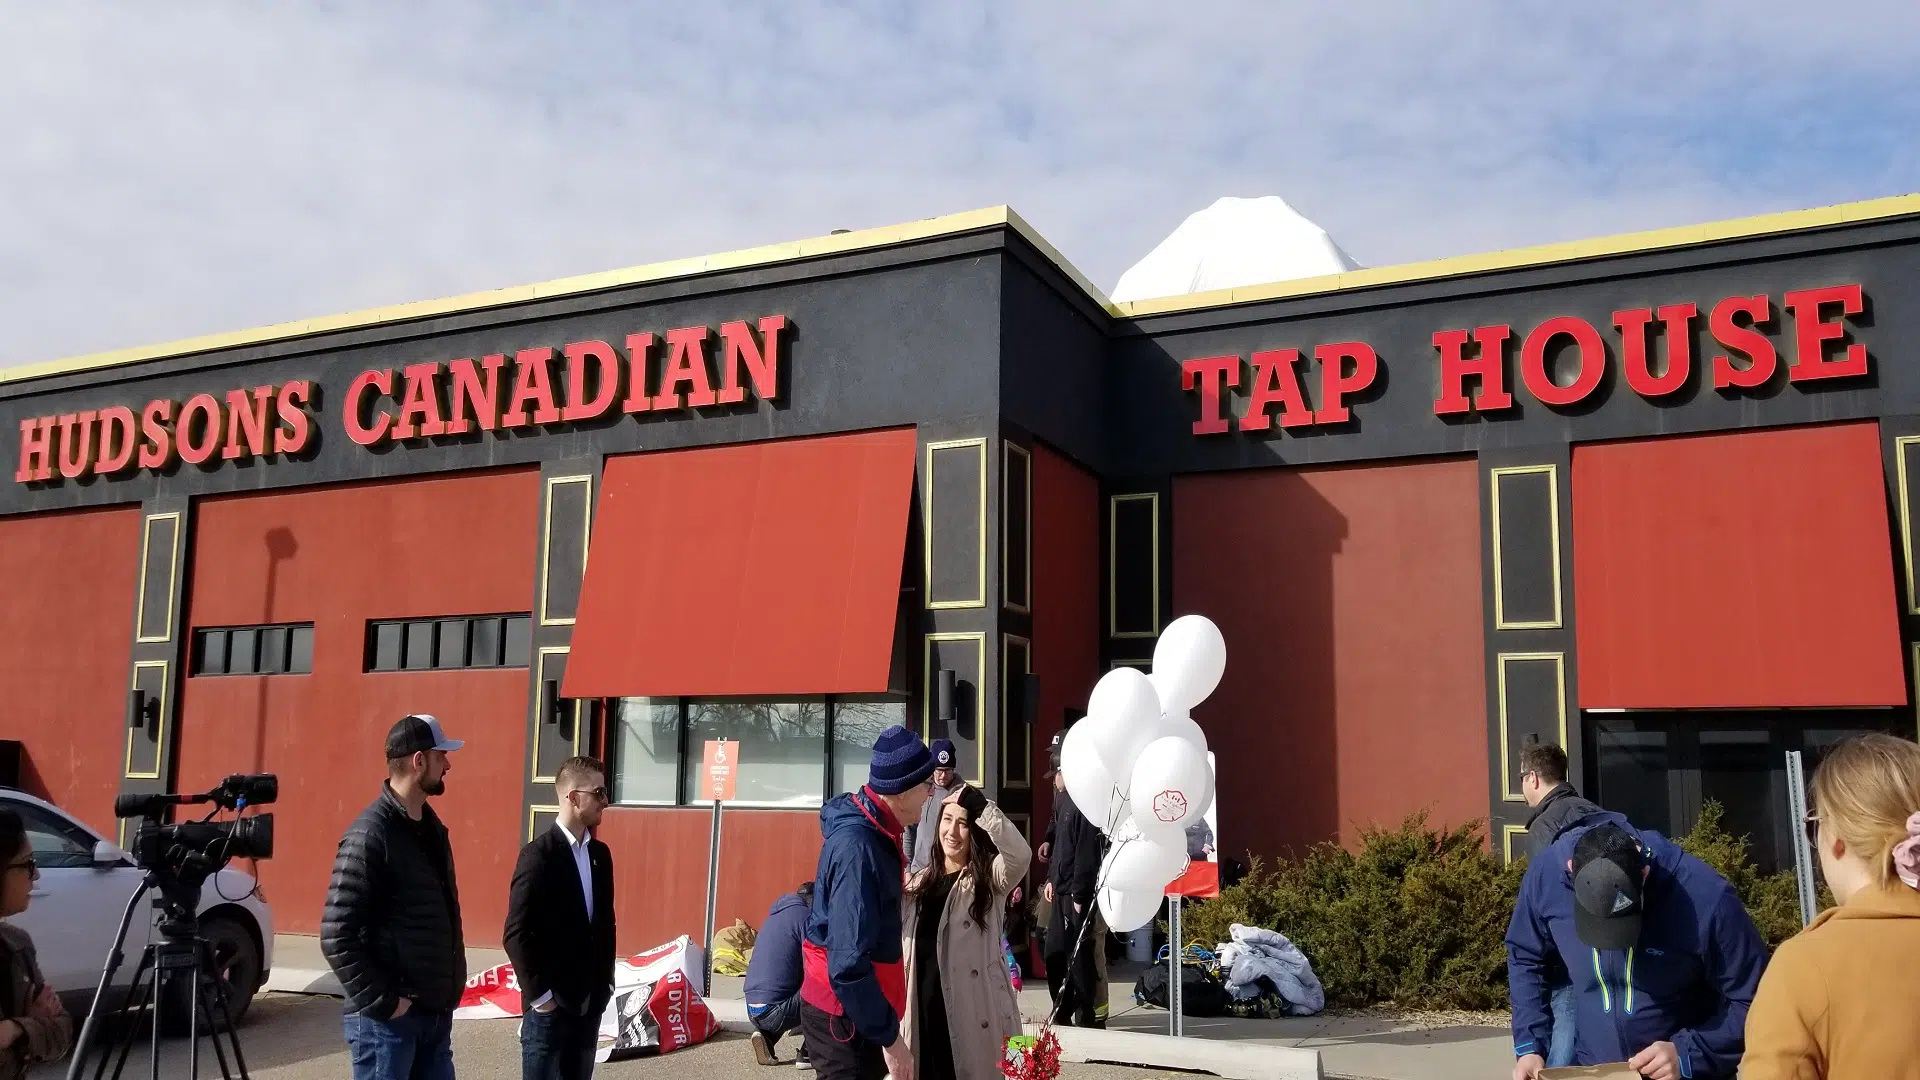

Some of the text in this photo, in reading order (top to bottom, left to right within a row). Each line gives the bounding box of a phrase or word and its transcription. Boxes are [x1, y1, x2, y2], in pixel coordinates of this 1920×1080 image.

[15, 315, 786, 483] HUDSONS CANADIAN
[1181, 284, 1869, 436] TAP HOUSE
[667, 989, 687, 1049] DYSTR
